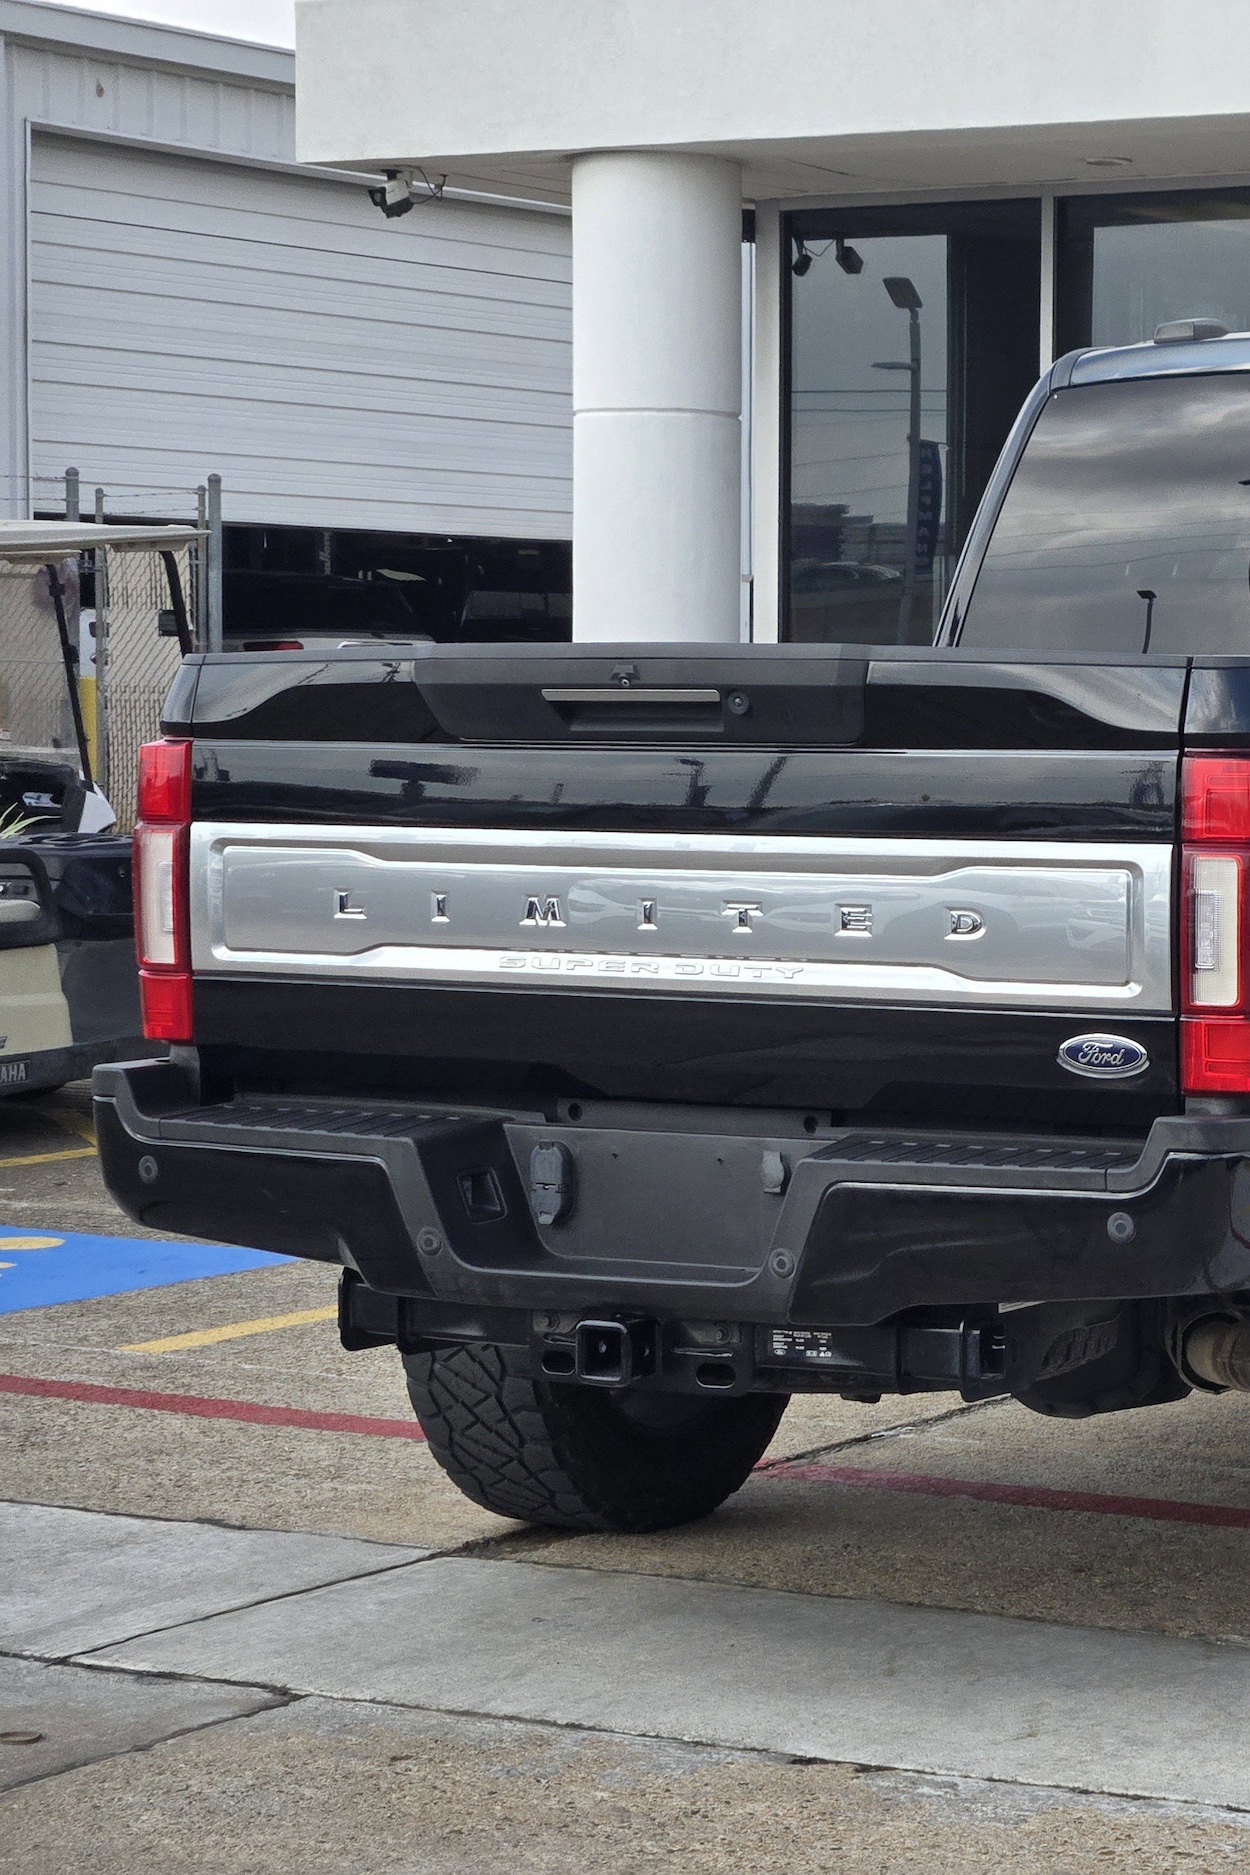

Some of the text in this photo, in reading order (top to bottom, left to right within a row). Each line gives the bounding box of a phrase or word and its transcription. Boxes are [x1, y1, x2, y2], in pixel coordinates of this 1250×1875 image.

[333, 887, 988, 941] LIMITED
[498, 956, 805, 980] SUPER DUTY
[1077, 1041, 1126, 1066] Ford
[0, 1063, 26, 1083] AHA
